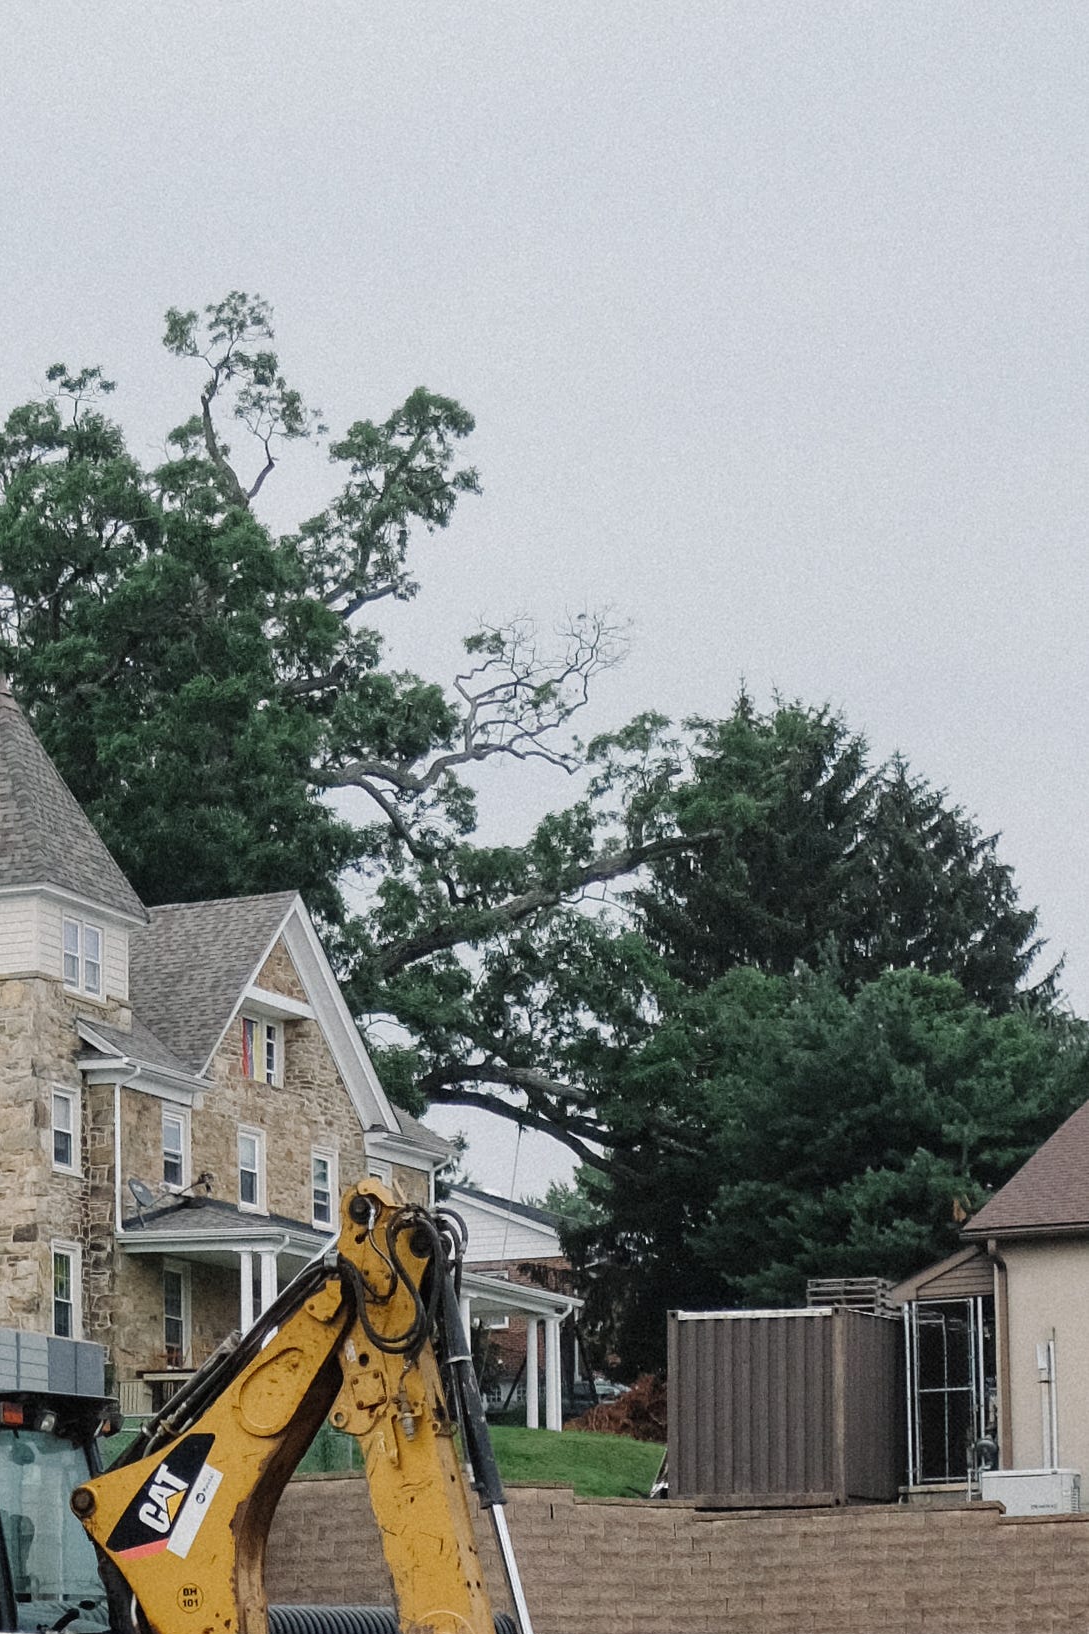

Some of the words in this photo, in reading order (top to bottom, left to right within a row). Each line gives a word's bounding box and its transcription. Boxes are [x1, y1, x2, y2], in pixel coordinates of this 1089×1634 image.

[138, 1464, 190, 1534] CAT
[183, 1588, 197, 1596] BH
[182, 1599, 199, 1607] 101
